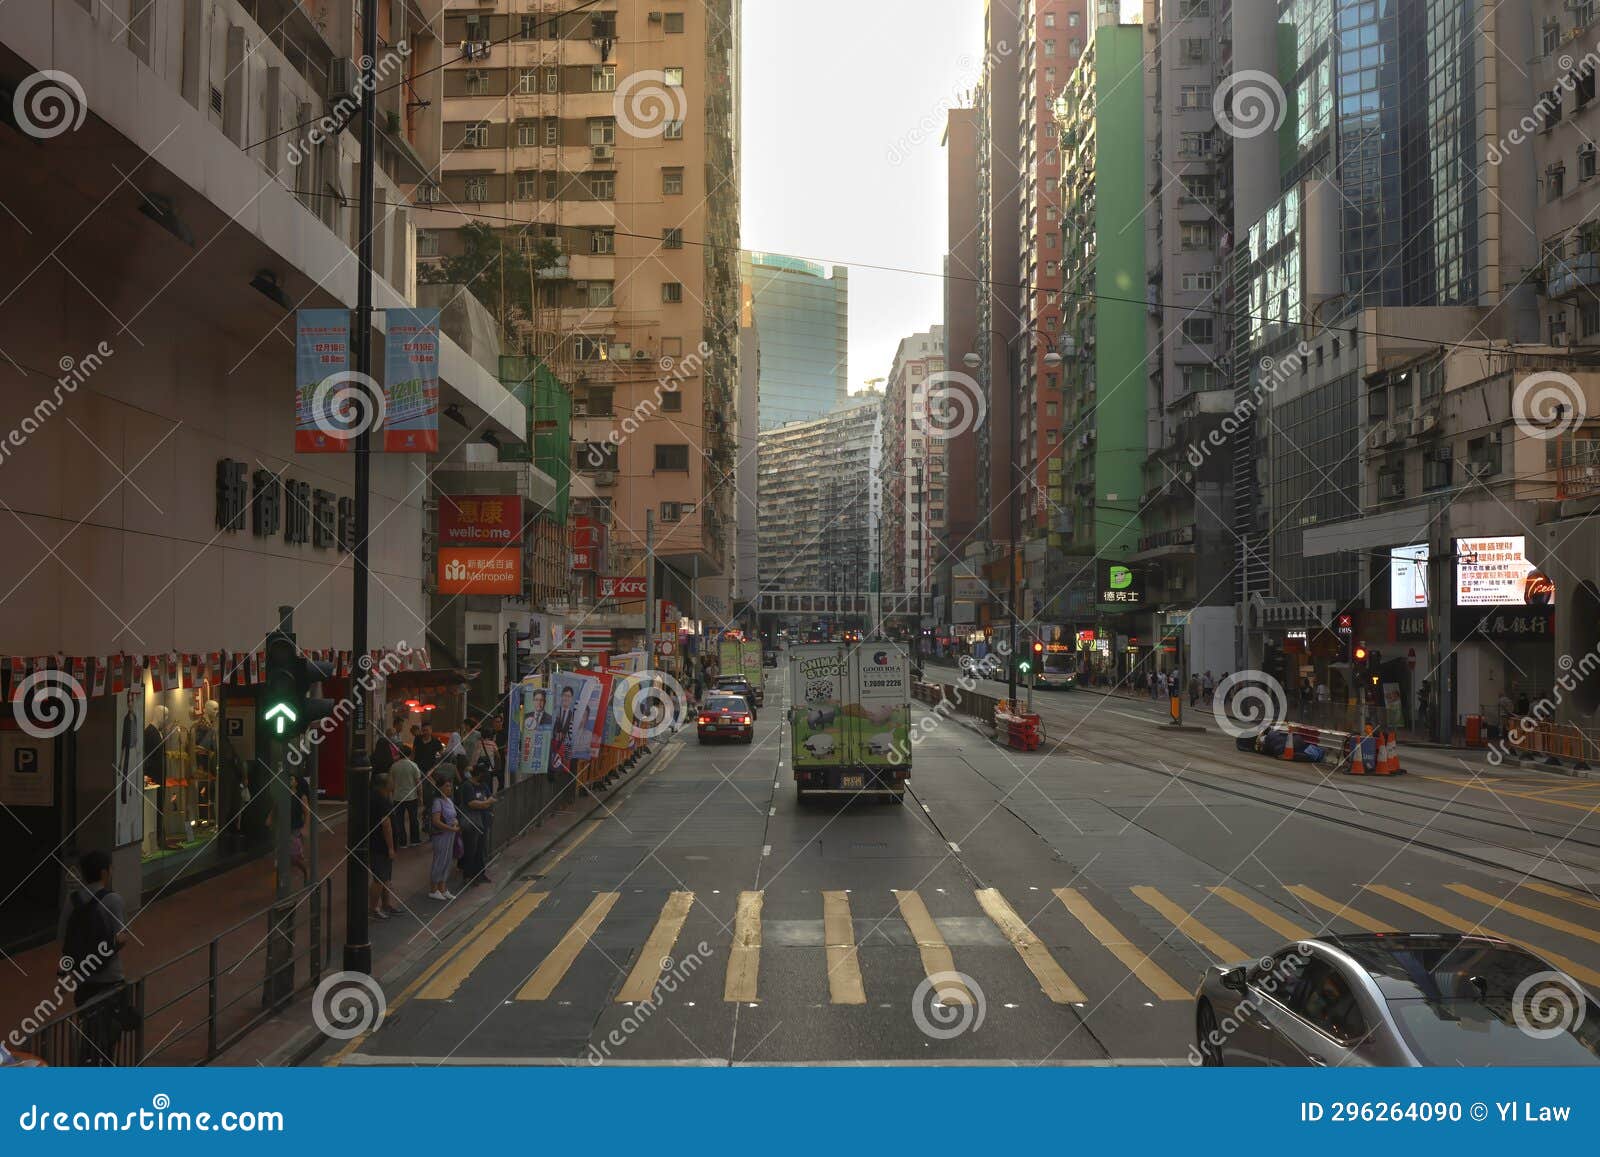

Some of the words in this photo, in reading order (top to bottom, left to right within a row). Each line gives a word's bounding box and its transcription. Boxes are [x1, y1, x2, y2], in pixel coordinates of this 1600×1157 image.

[457, 501, 503, 524] 惠康
[449, 526, 511, 539] wellcome
[467, 559, 514, 570] 新都城百貨
[466, 572, 514, 583] Metropole
[619, 582, 648, 594] KFC
[1104, 591, 1138, 602] 德克士
[1338, 626, 1352, 634] DBS
[799, 655, 848, 674] ANIMAL
[805, 665, 849, 680] STOOL
